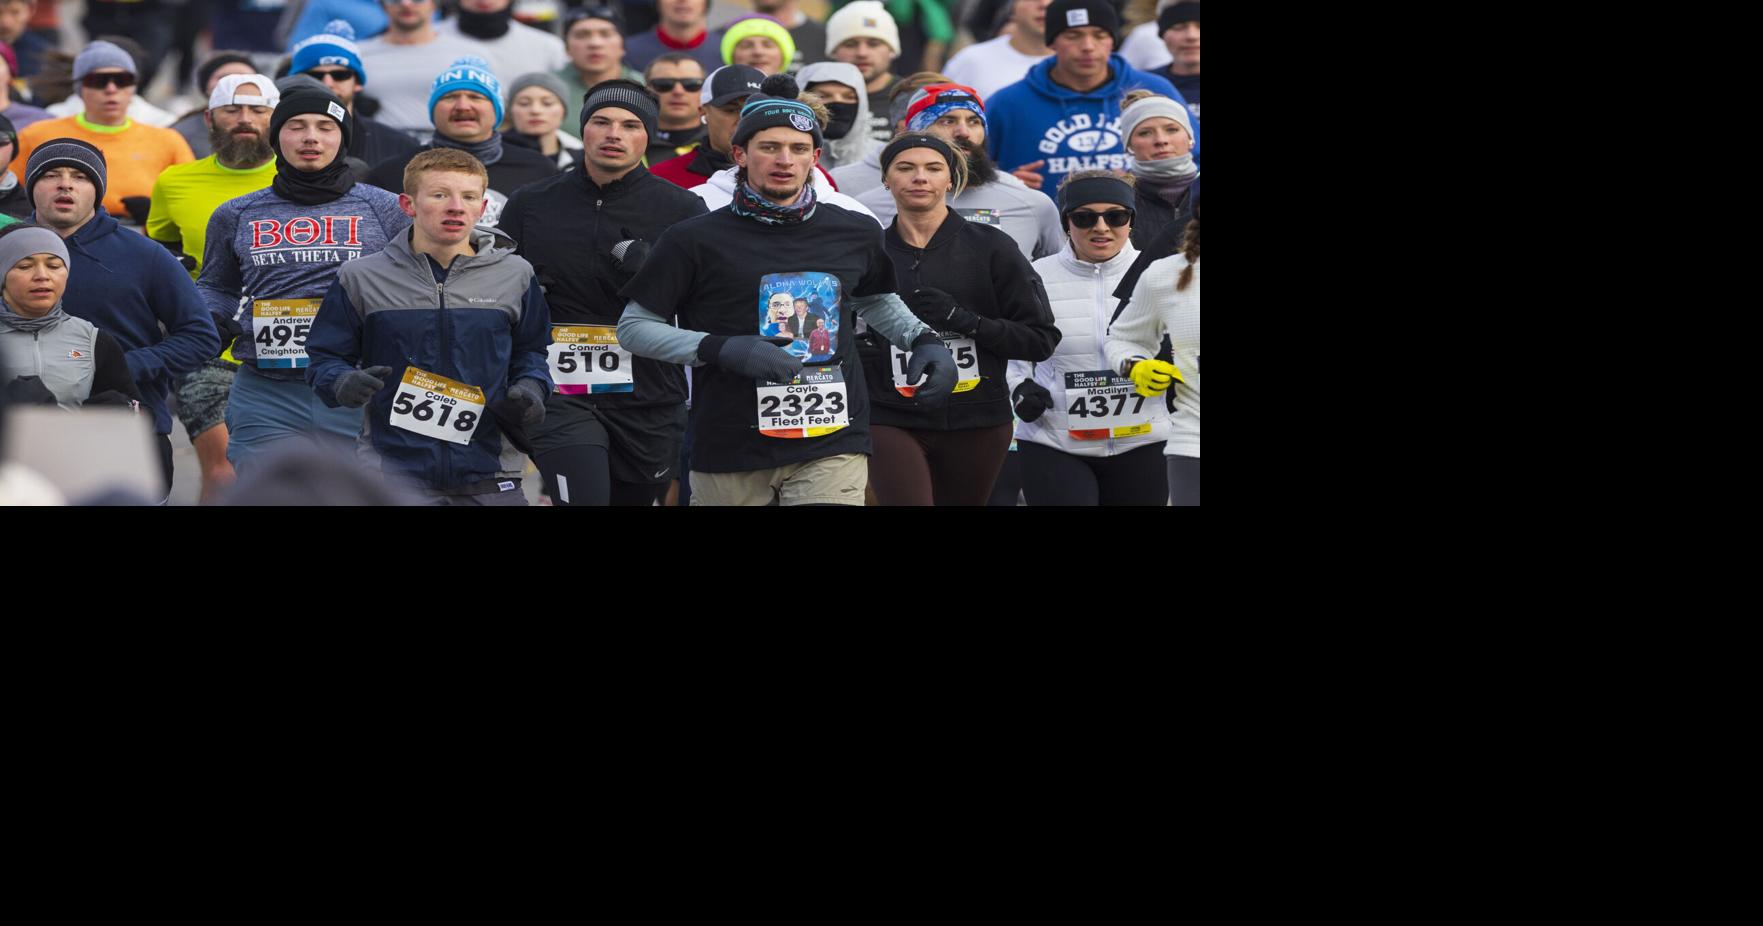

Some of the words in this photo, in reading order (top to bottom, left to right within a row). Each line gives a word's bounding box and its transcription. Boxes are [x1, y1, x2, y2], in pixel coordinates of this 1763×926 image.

[251, 252, 286, 267] BETA
[292, 250, 340, 262] THETA
[348, 250, 361, 261] PI
[272, 317, 311, 325] Andrew
[261, 348, 305, 356] Creighton
[568, 343, 609, 351] Conrad
[557, 351, 620, 373] 510
[786, 385, 818, 394] Cayle
[1087, 387, 1128, 395] Madilyn
[425, 391, 457, 406] Caleb
[760, 391, 845, 417] 2323
[1068, 392, 1146, 418] 4377
[393, 391, 478, 432] 5618
[771, 416, 804, 427] Fleet
[808, 415, 835, 425] Feet
